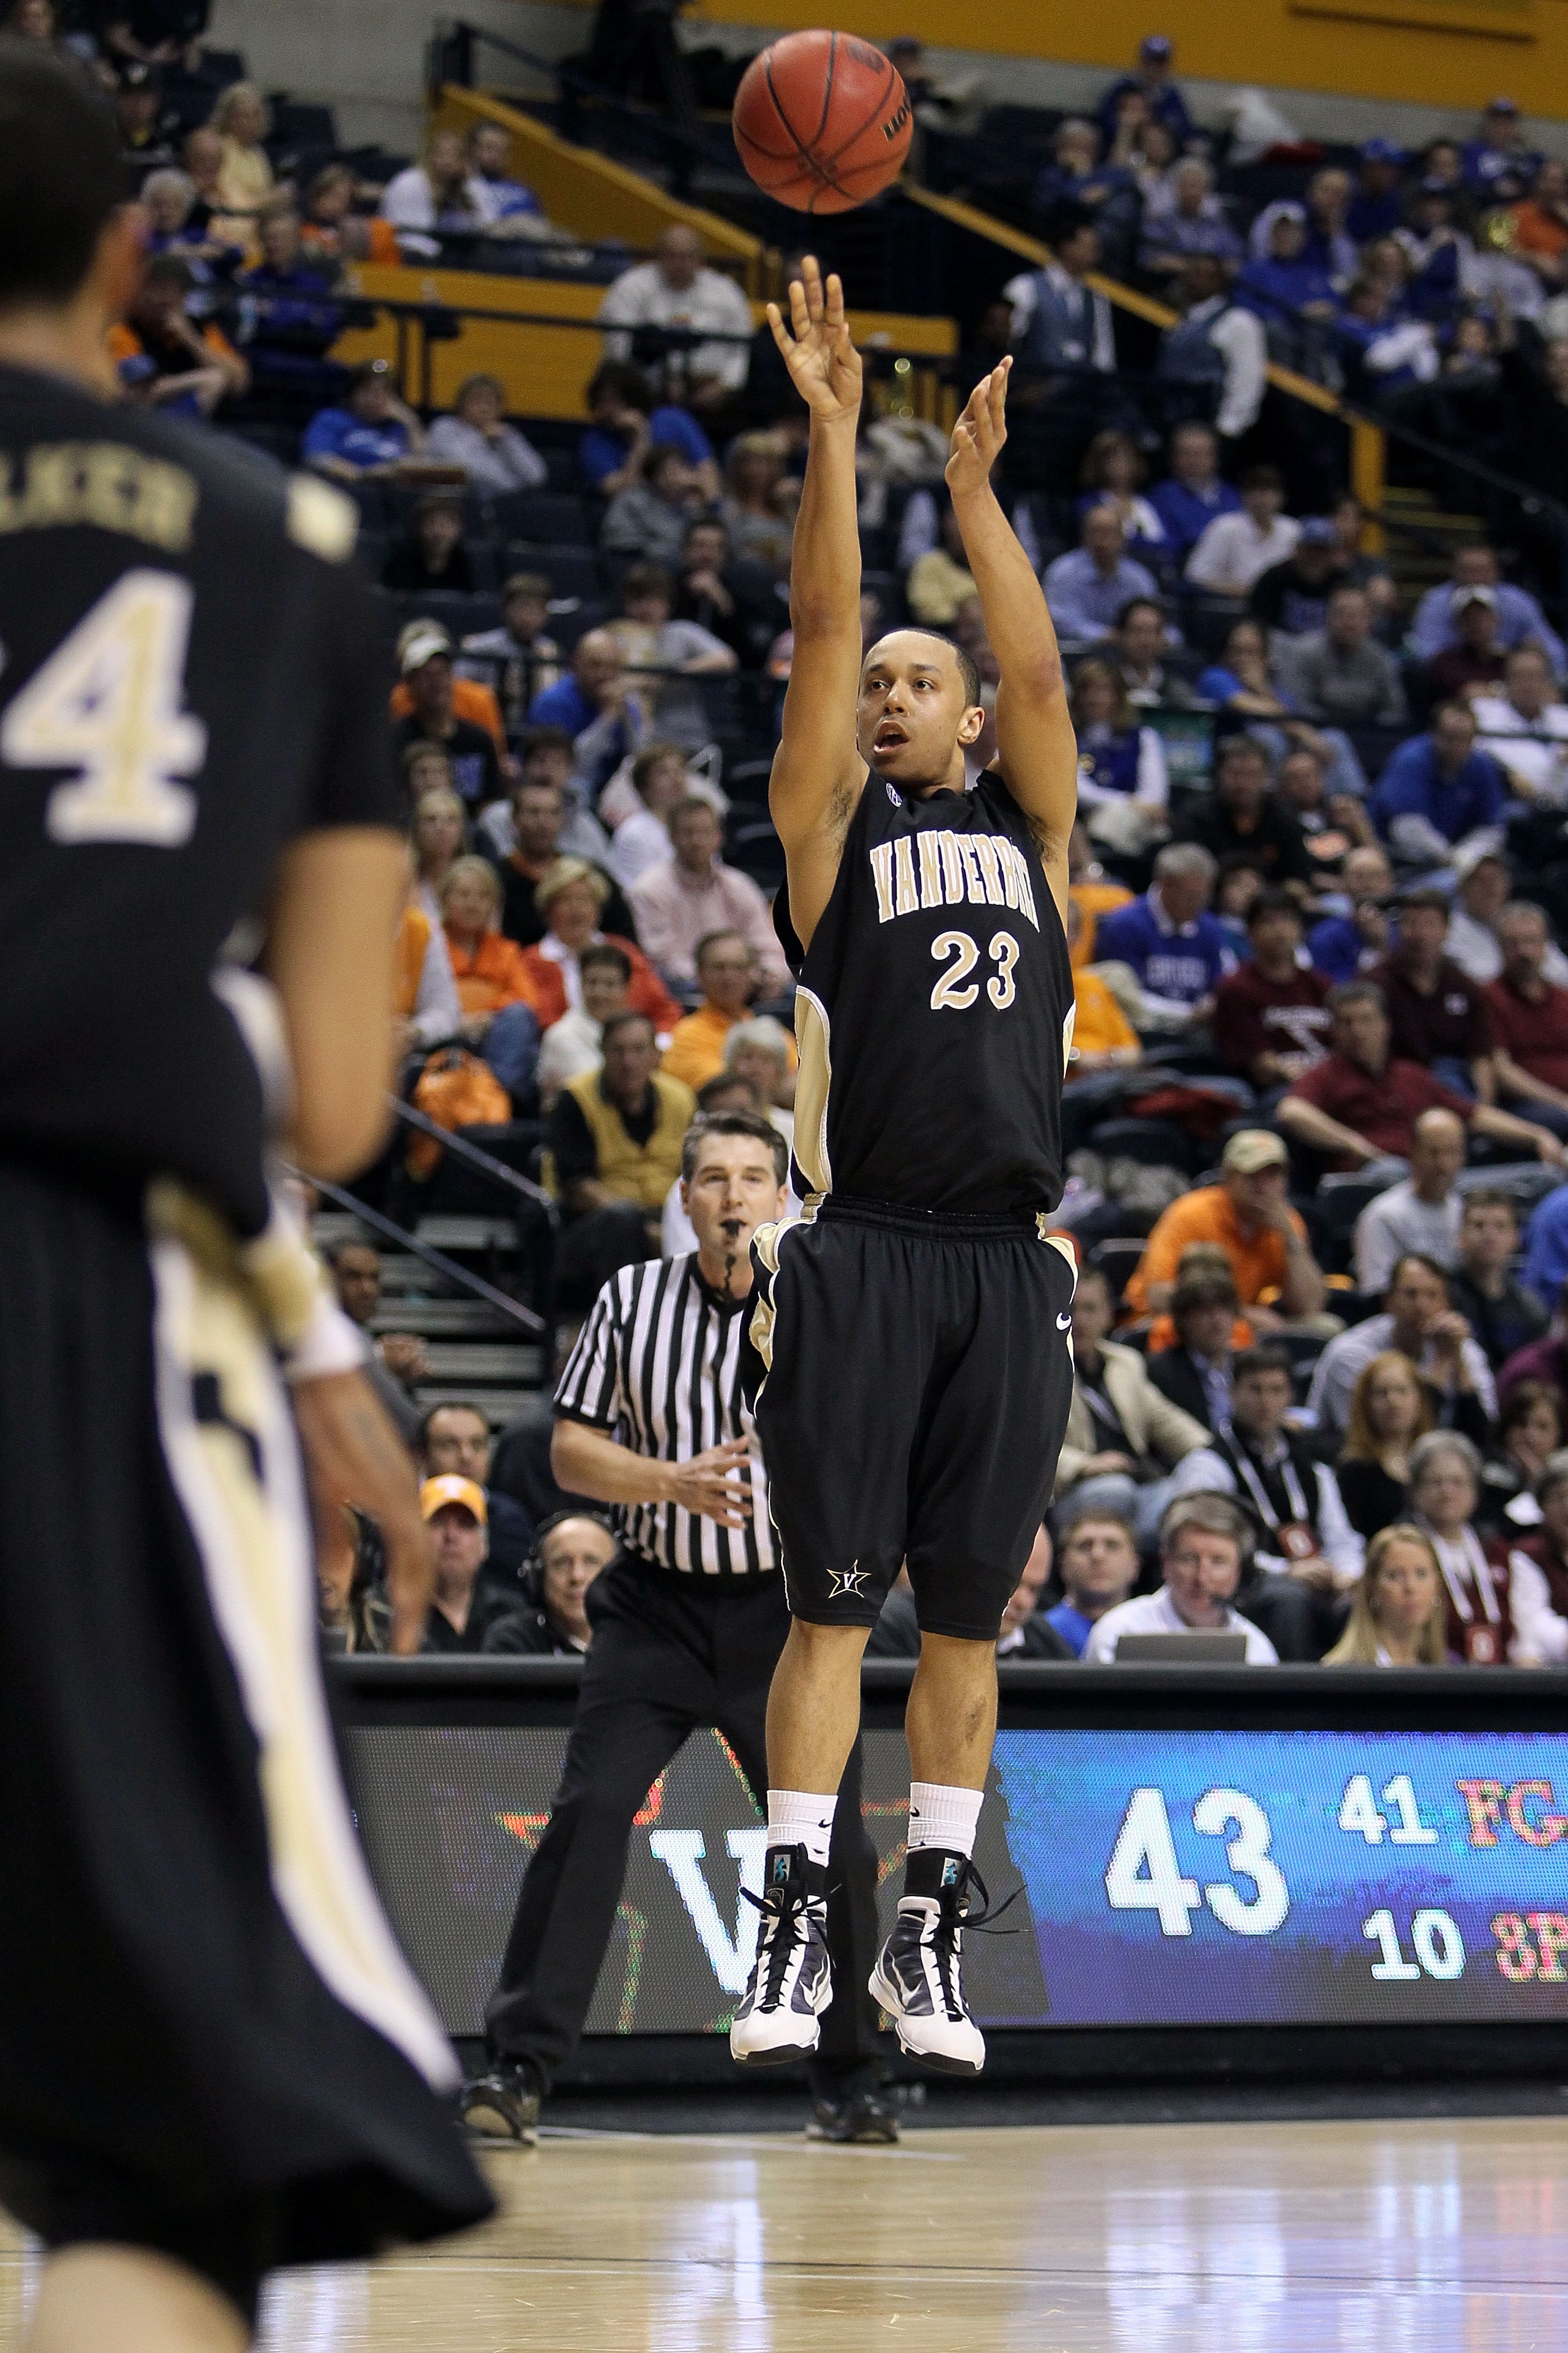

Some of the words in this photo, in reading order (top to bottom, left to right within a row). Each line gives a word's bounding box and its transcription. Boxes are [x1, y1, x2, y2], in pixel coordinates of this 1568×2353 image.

[931, 930, 1020, 1010] 23
[1338, 1775, 1439, 1844] 41
[1455, 1779, 1568, 1848] FG
[1105, 1788, 1289, 1936] 43
[649, 1828, 769, 1995] V
[1364, 1909, 1466, 1980] 10
